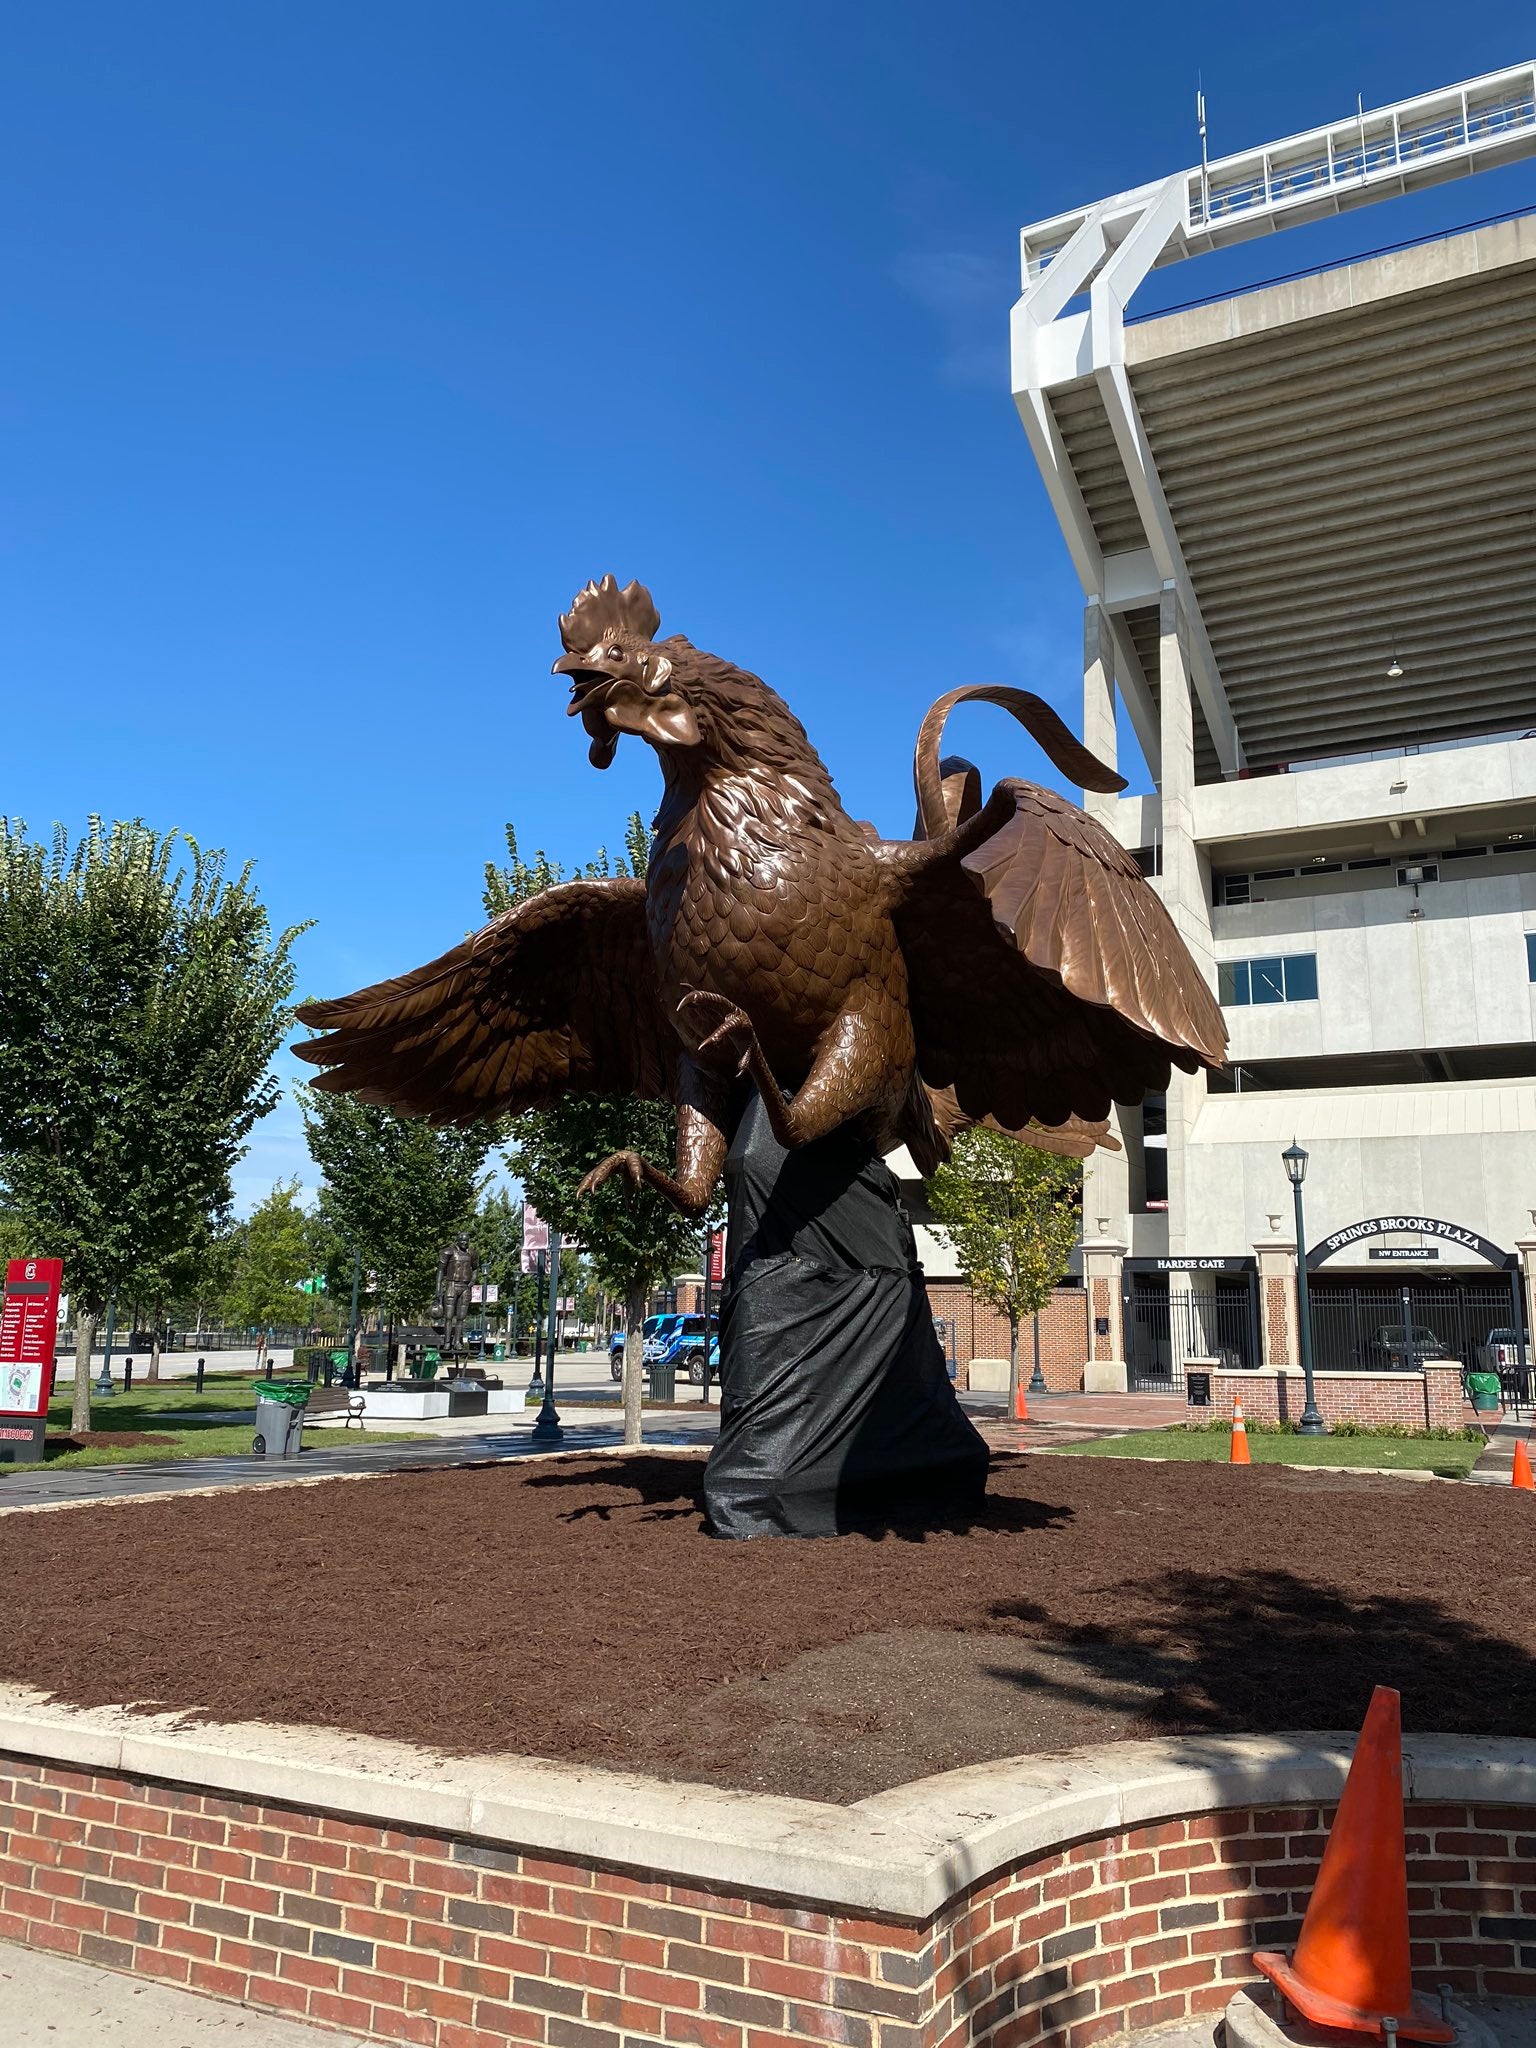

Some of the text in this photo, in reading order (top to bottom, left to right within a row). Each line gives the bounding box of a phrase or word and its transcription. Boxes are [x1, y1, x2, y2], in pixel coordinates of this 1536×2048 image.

[1326, 1218, 1479, 1250] SPRINGS BROOKS PLAZA
[1157, 1259, 1226, 1269] HARDEE GATE
